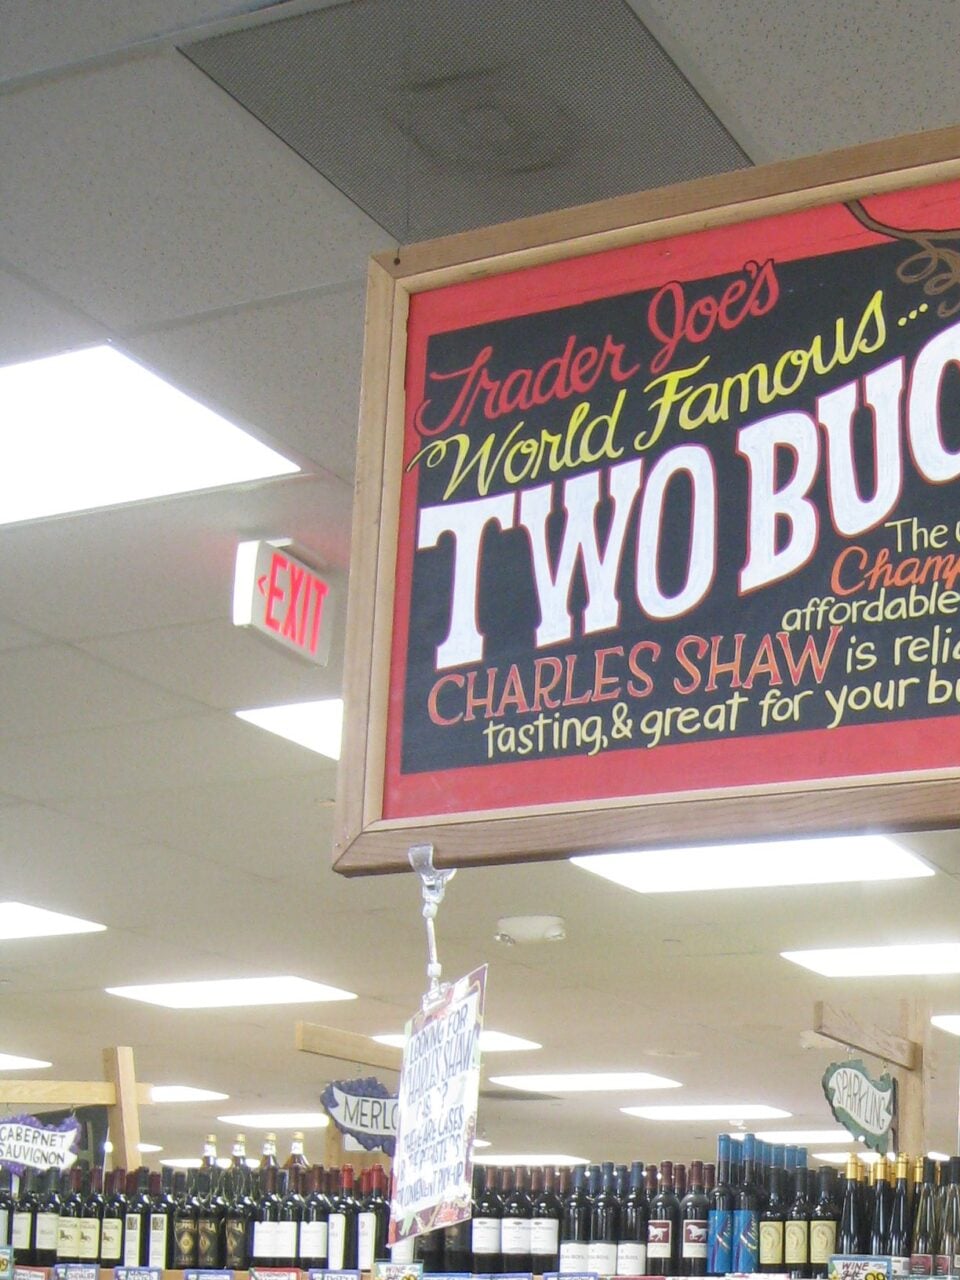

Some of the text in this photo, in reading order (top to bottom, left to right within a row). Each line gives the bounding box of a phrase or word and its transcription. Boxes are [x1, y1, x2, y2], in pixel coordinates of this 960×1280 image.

[416, 258, 780, 437] Trader Joe's
[407, 390, 625, 499] World
[417, 443, 718, 670] TWO
[885, 518, 948, 553] The
[265, 552, 331, 658] EXIT
[781, 585, 960, 631] affordable
[427, 640, 673, 728] CHARLES
[674, 624, 842, 698] SHAW
[846, 638, 877, 674] is
[640, 696, 748, 748] great
[760, 689, 814, 727] for
[824, 676, 920, 728] your
[835, 1069, 886, 1130] SPARKLING
[0, 1125, 67, 1149] CABERNET
[0, 1142, 66, 1165] SAUVIGNON
